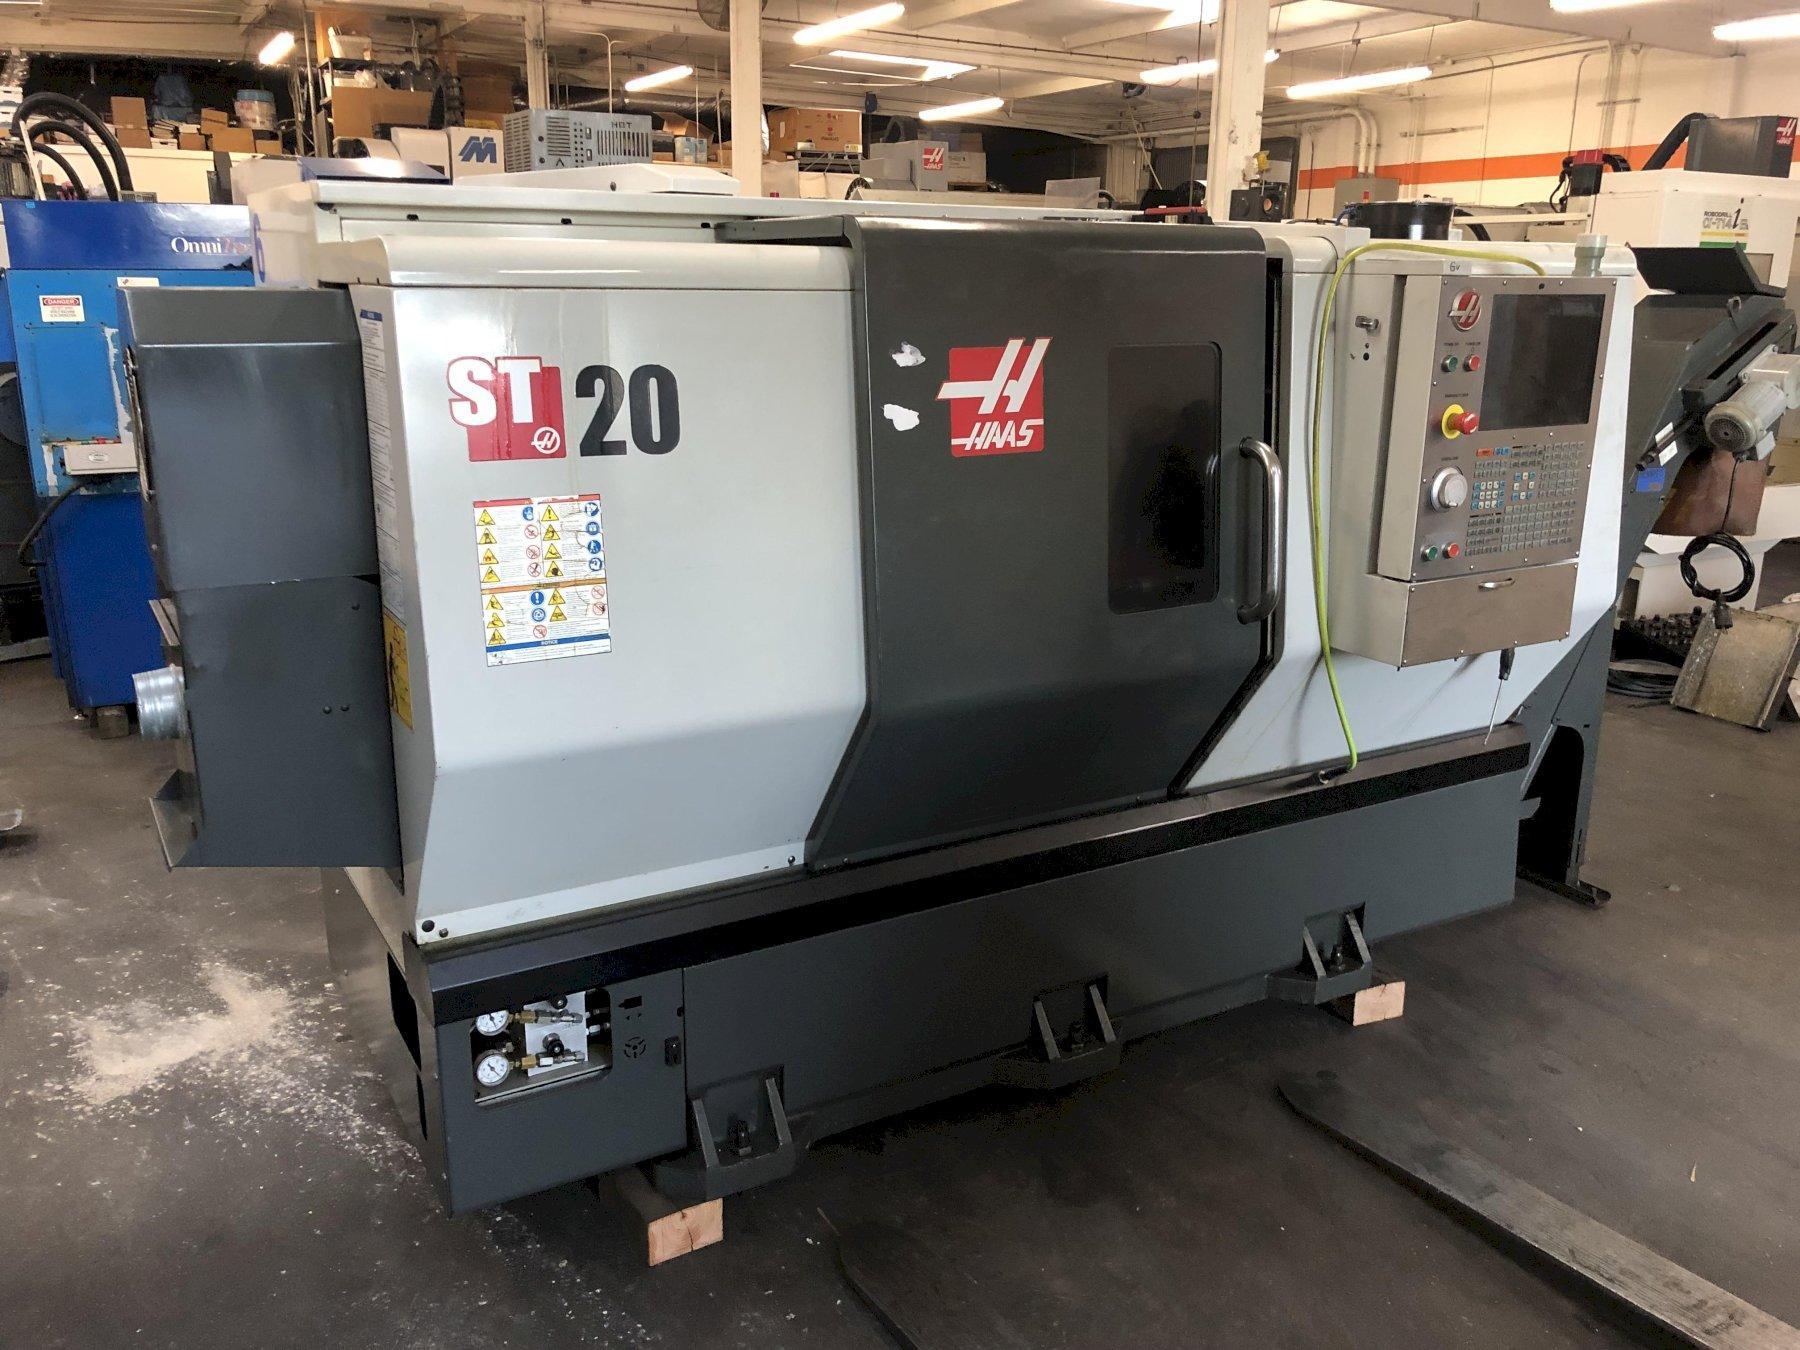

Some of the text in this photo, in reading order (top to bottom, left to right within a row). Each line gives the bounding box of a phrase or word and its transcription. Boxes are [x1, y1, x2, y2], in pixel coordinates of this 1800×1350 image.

[46, 297, 77, 305] DANGER
[448, 356, 543, 426] ST
[575, 364, 681, 455] 20
[951, 419, 1044, 450] HAAS
